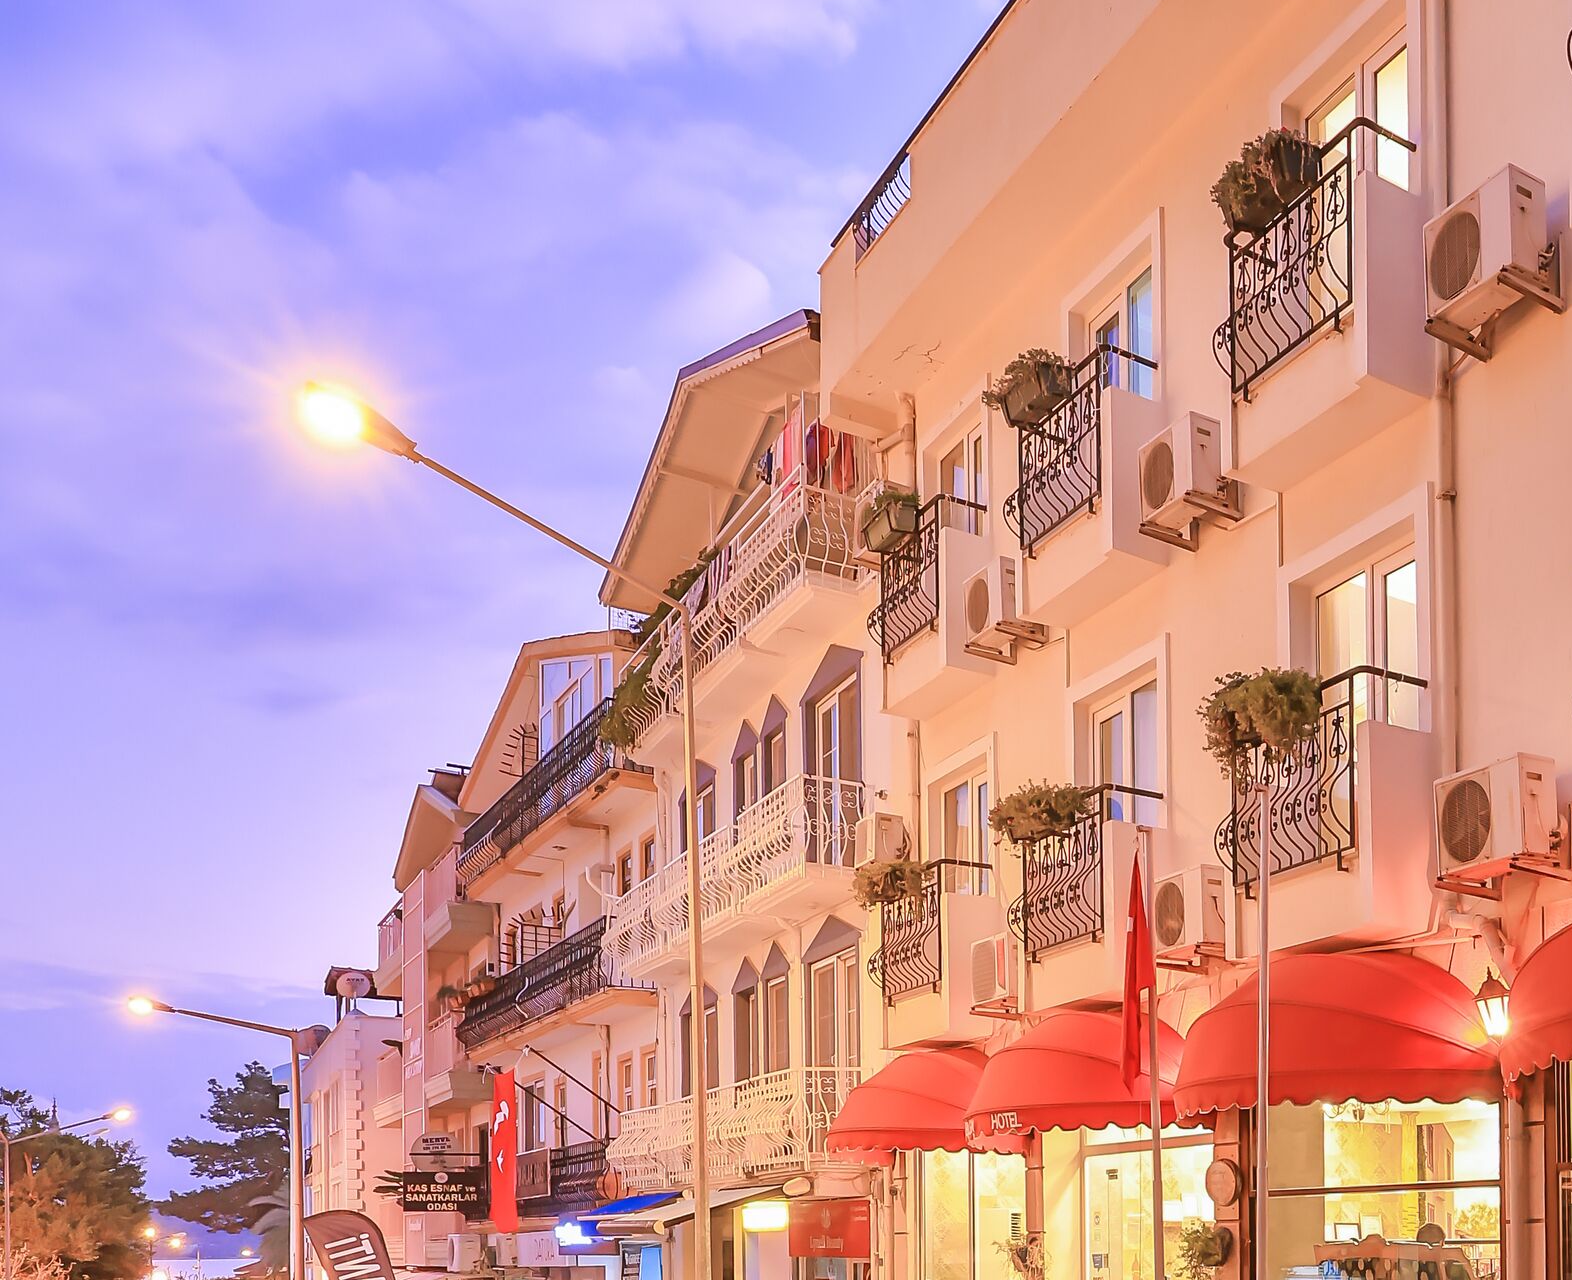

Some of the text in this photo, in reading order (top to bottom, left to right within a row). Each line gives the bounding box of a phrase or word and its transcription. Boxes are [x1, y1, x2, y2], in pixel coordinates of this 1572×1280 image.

[990, 1111, 1022, 1130] HOTEL
[430, 1184, 463, 1193] ESNAF
[405, 1193, 478, 1202] SANATKARLAR
[426, 1202, 458, 1211] ODASI
